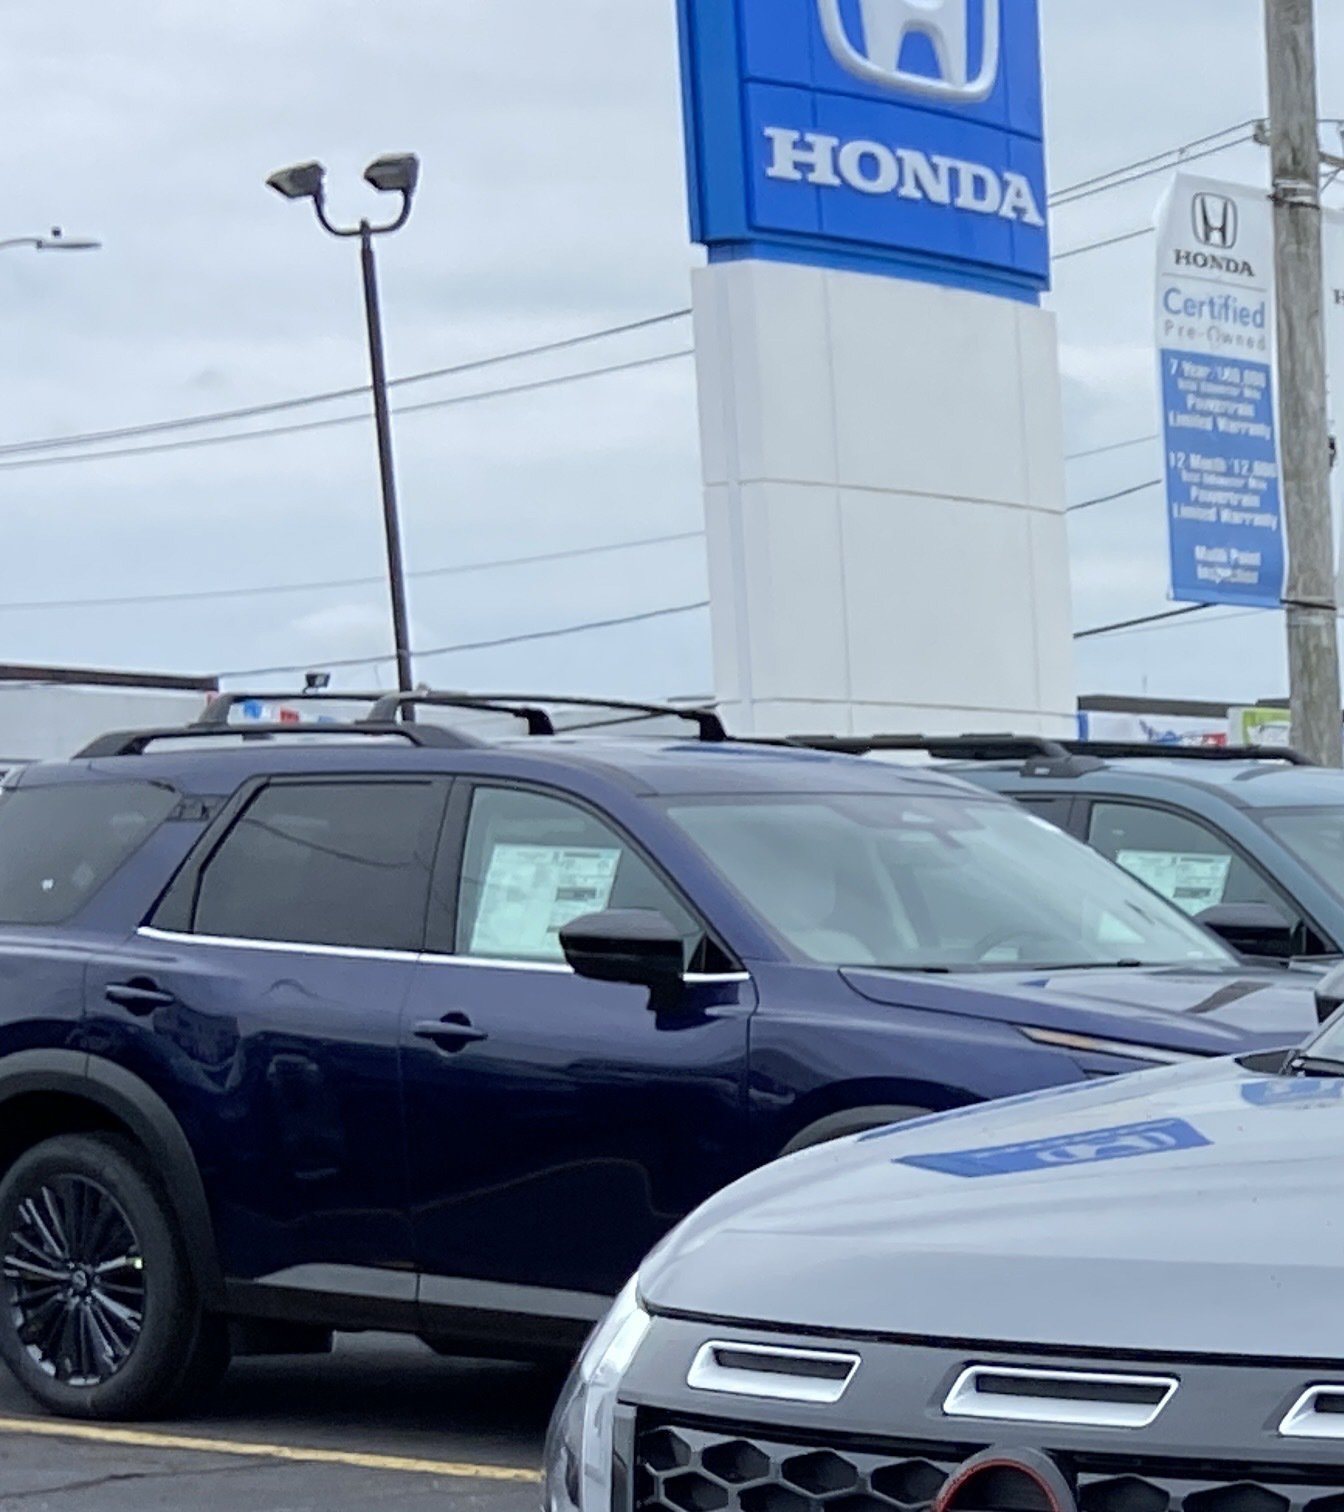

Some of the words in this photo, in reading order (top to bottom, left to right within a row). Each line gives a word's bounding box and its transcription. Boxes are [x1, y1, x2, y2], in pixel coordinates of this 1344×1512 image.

[763, 126, 1045, 227] HONDA
[1174, 248, 1255, 277] HONDA
[1163, 287, 1265, 329] Certified
